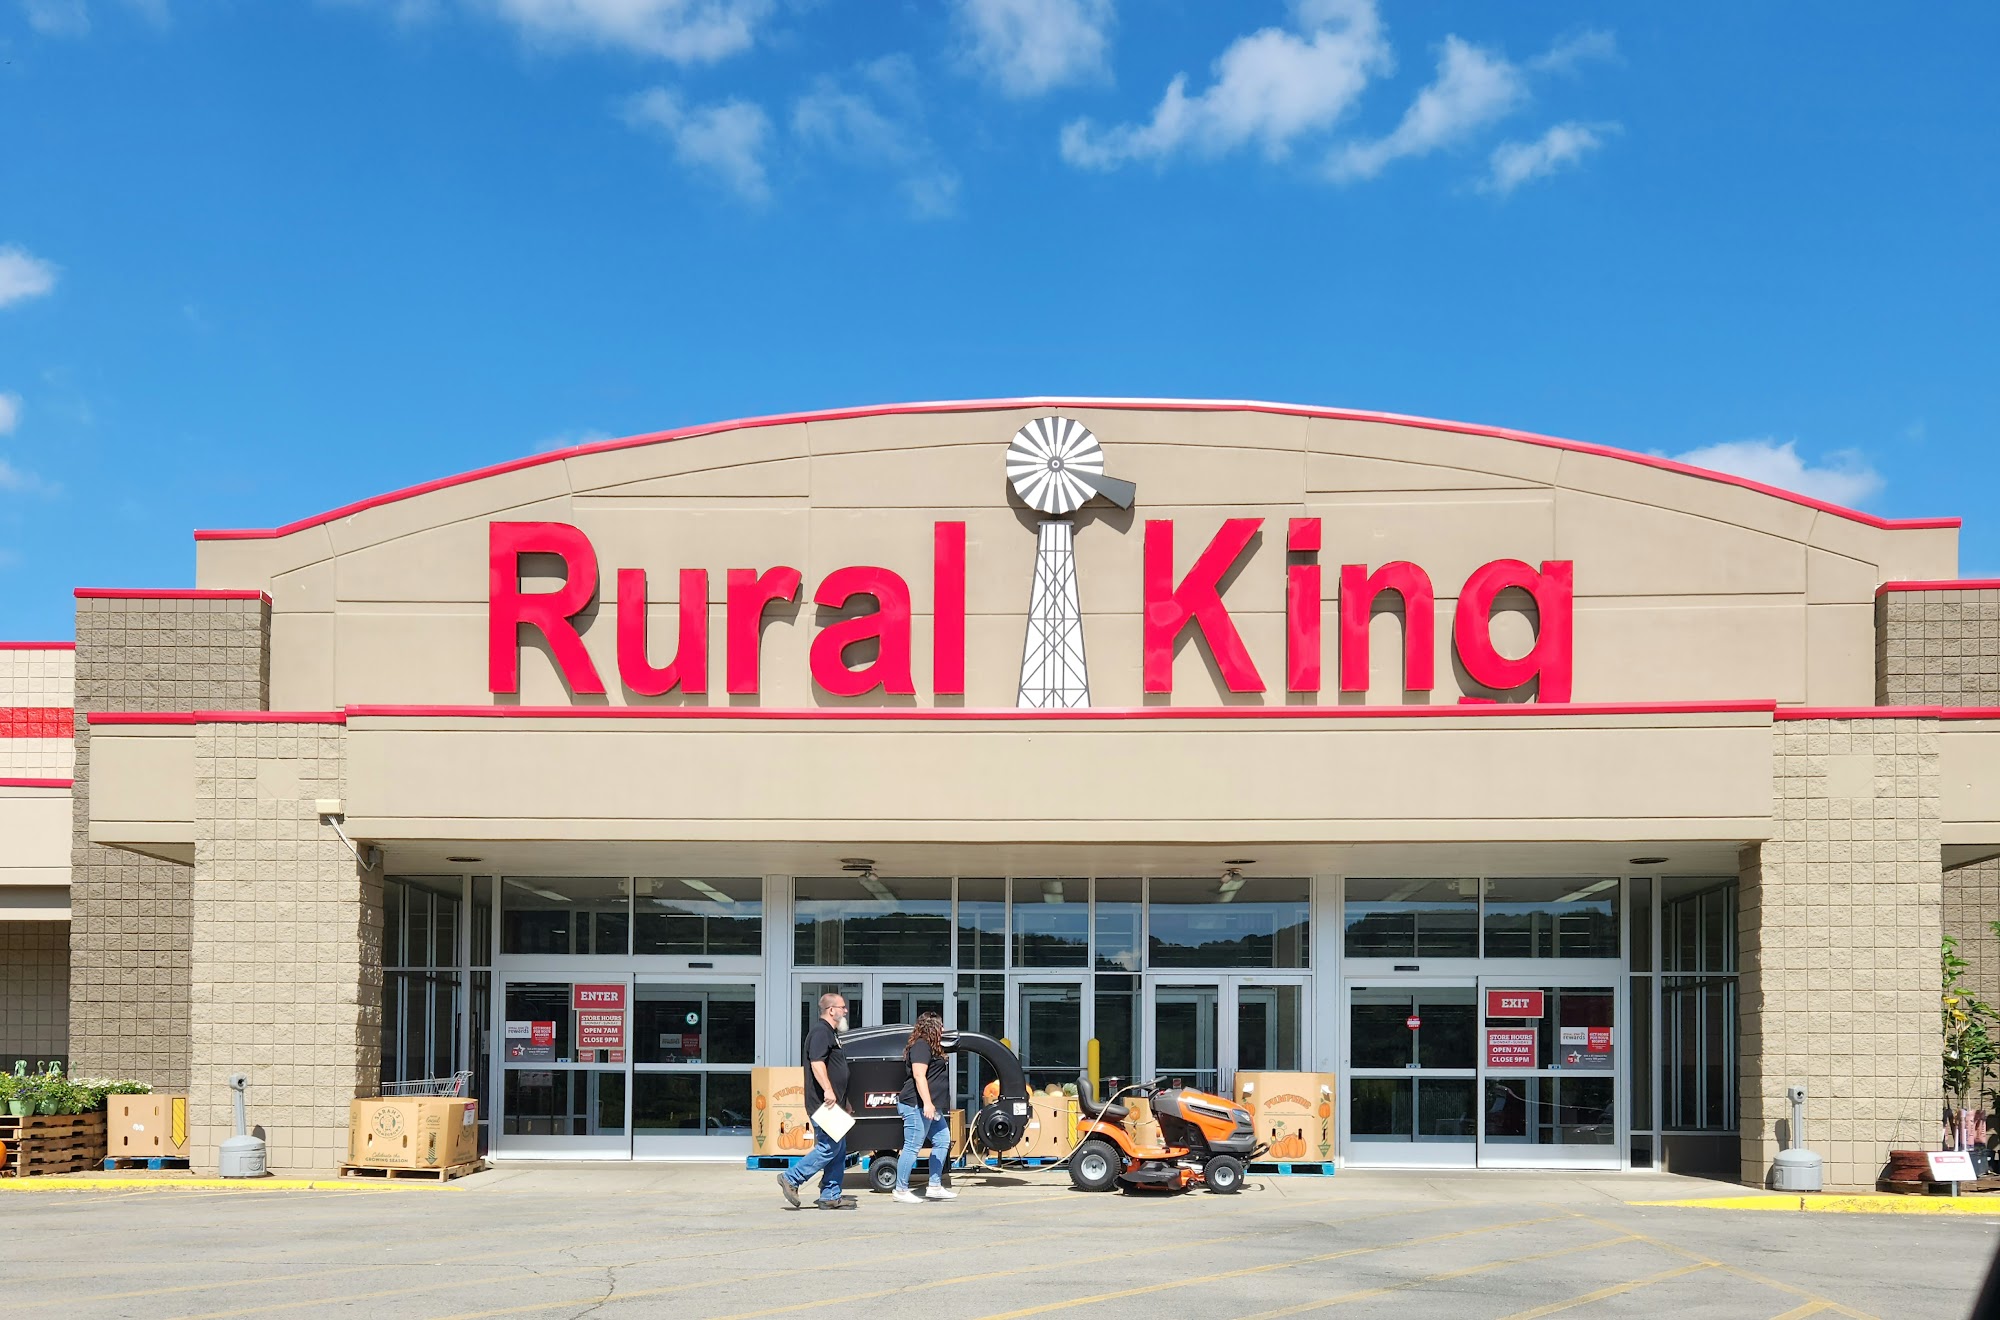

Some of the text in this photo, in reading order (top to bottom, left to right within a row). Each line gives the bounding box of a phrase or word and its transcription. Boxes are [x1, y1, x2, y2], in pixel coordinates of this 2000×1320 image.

[489, 517, 1574, 704] Rural King
[580, 991, 619, 1001] ENTER
[1501, 998, 1530, 1008] EXIT
[773, 1086, 804, 1100] PUMPK
[1264, 1093, 1311, 1109] PUMPKINS
[374, 1109, 401, 1120] SARAH'S
